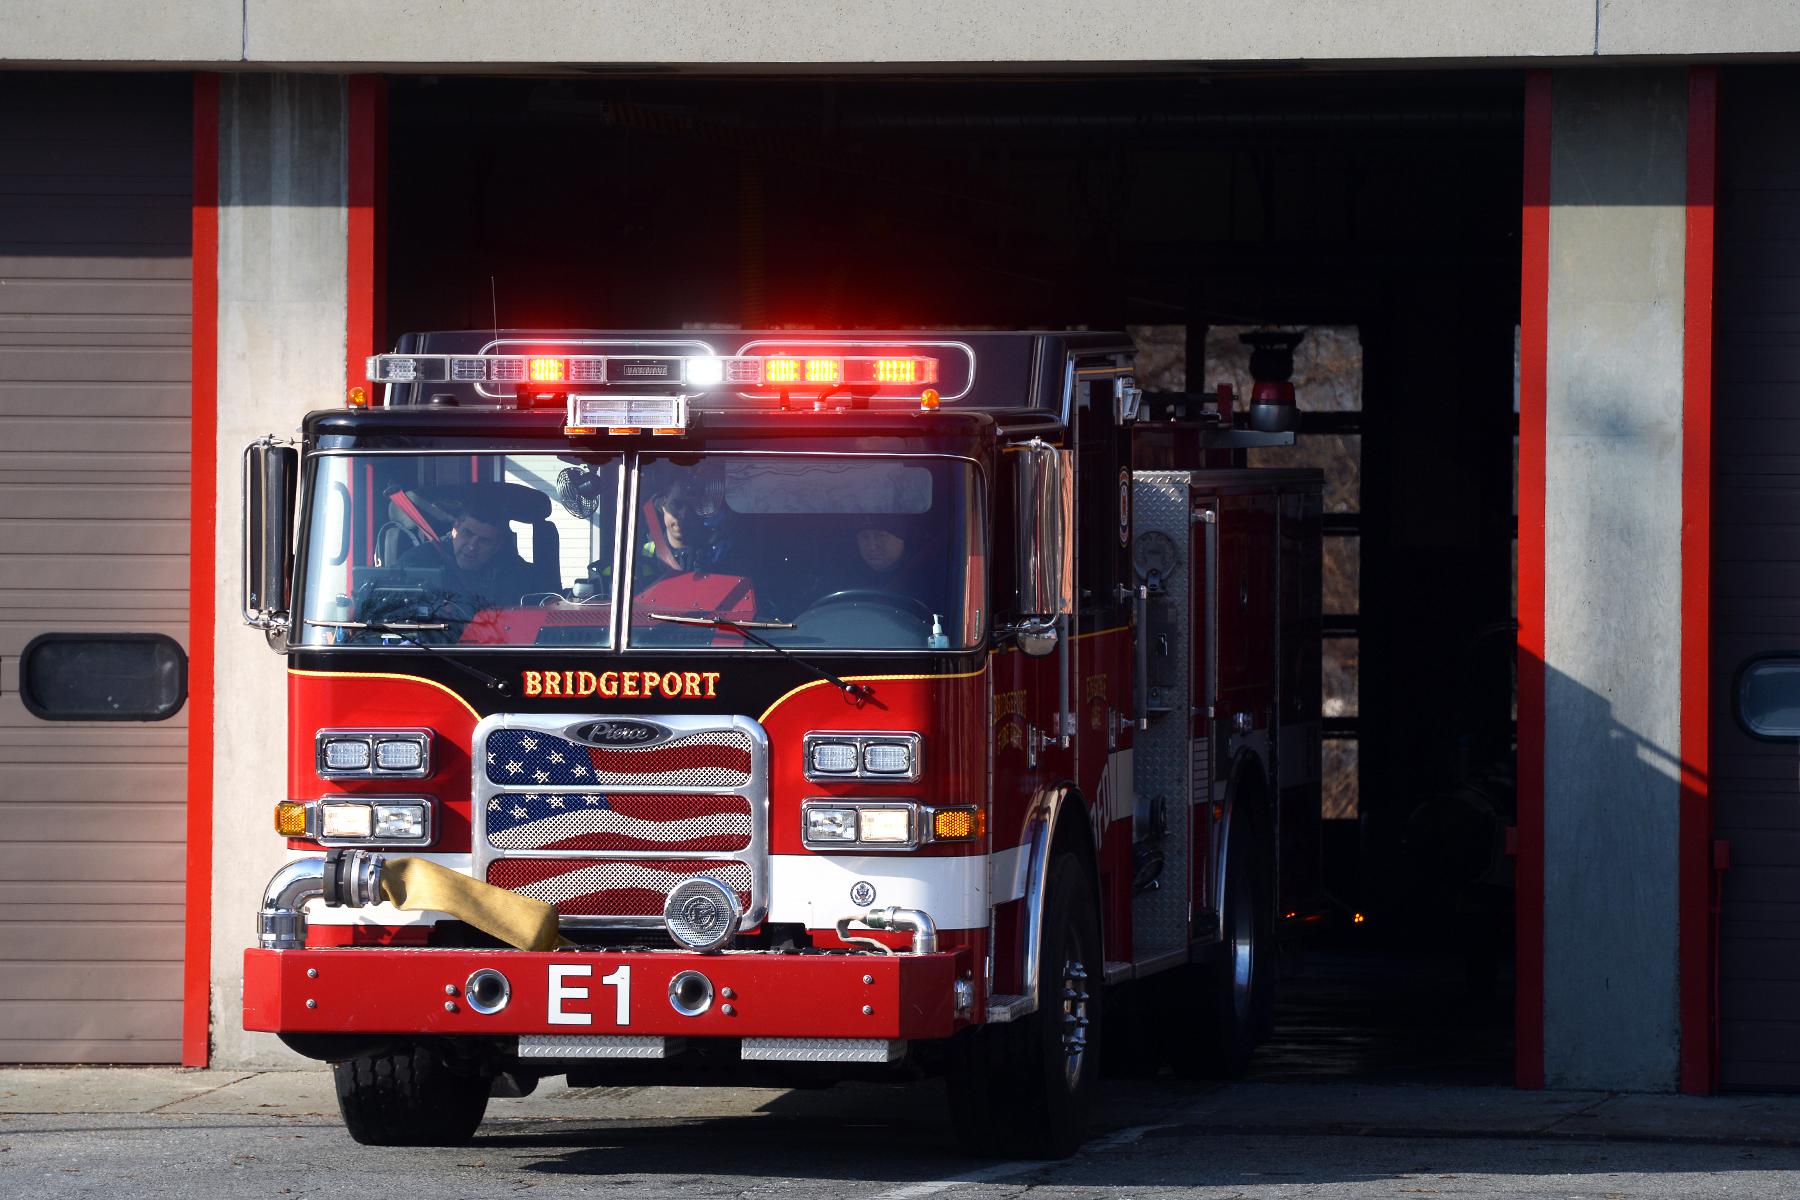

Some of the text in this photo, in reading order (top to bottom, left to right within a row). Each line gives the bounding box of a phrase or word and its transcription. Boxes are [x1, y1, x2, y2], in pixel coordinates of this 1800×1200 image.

[523, 671, 720, 699] BRIDGEPORT
[587, 722, 649, 743] Pierce
[547, 964, 631, 1025] E1
